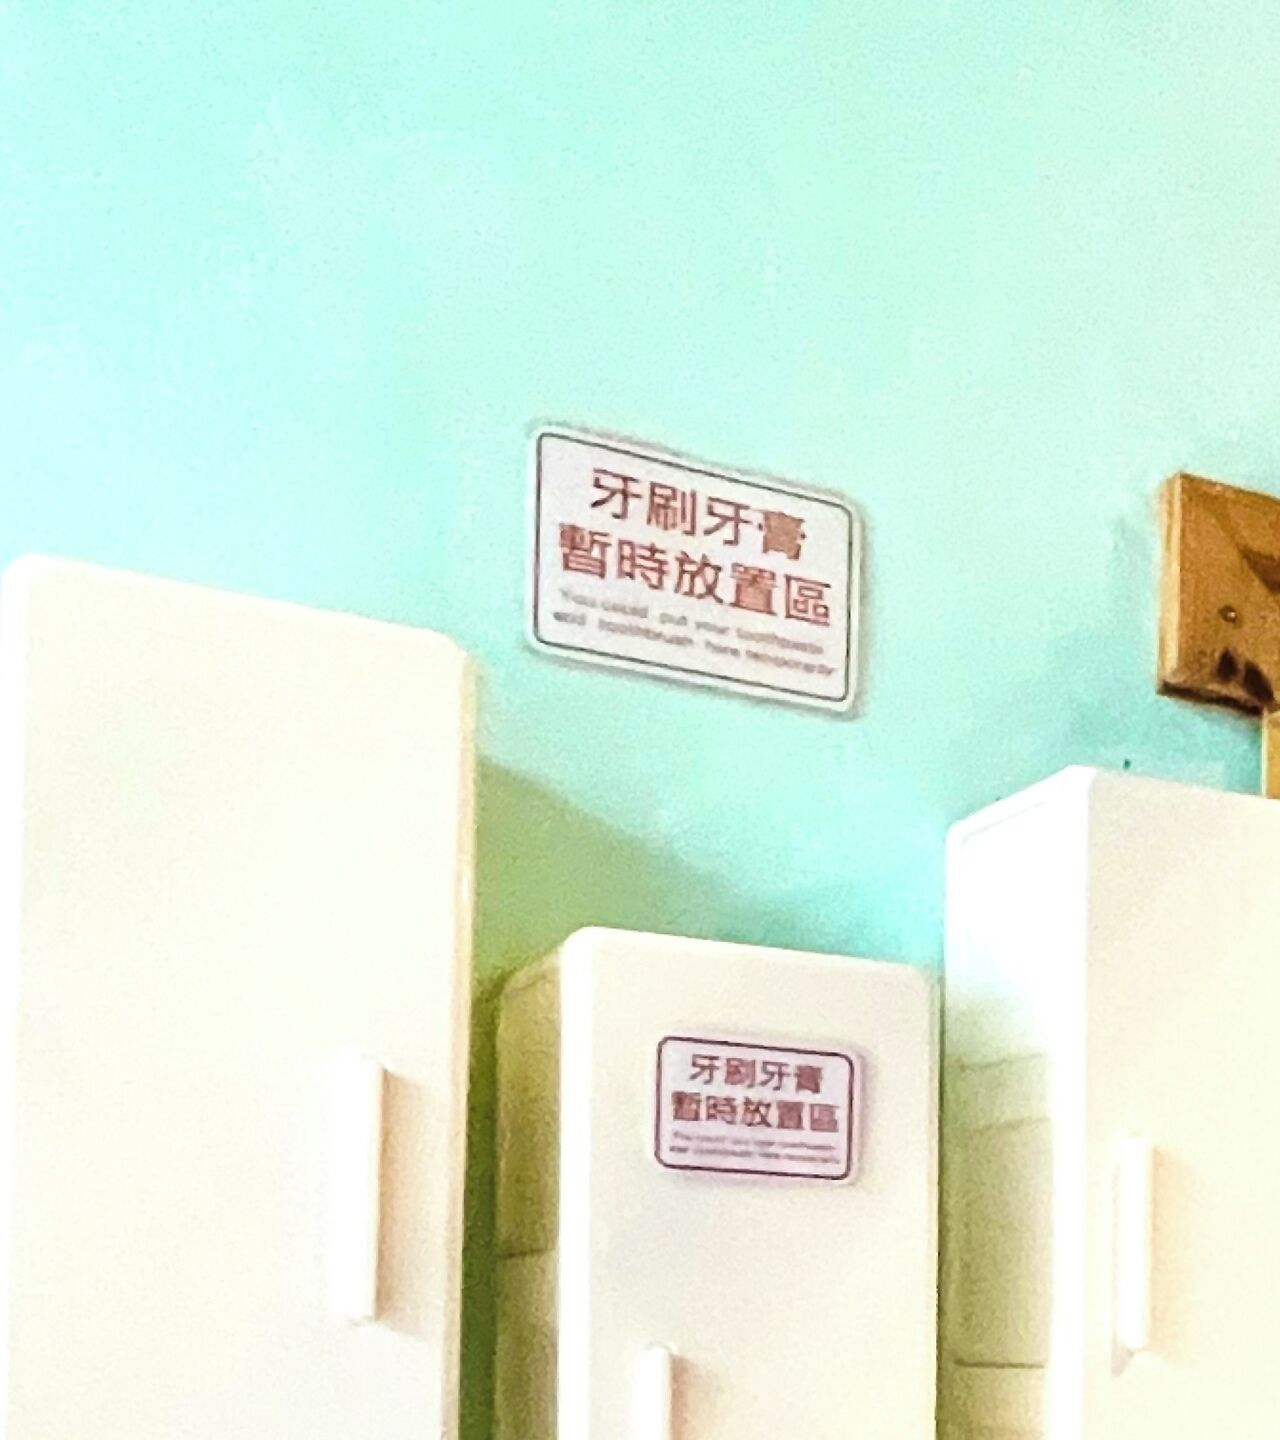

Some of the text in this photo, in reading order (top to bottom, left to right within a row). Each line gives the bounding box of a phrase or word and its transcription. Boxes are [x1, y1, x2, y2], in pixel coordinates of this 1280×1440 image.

[591, 468, 806, 560] 牙刷牙膏
[559, 523, 831, 626] 暫時放置區
